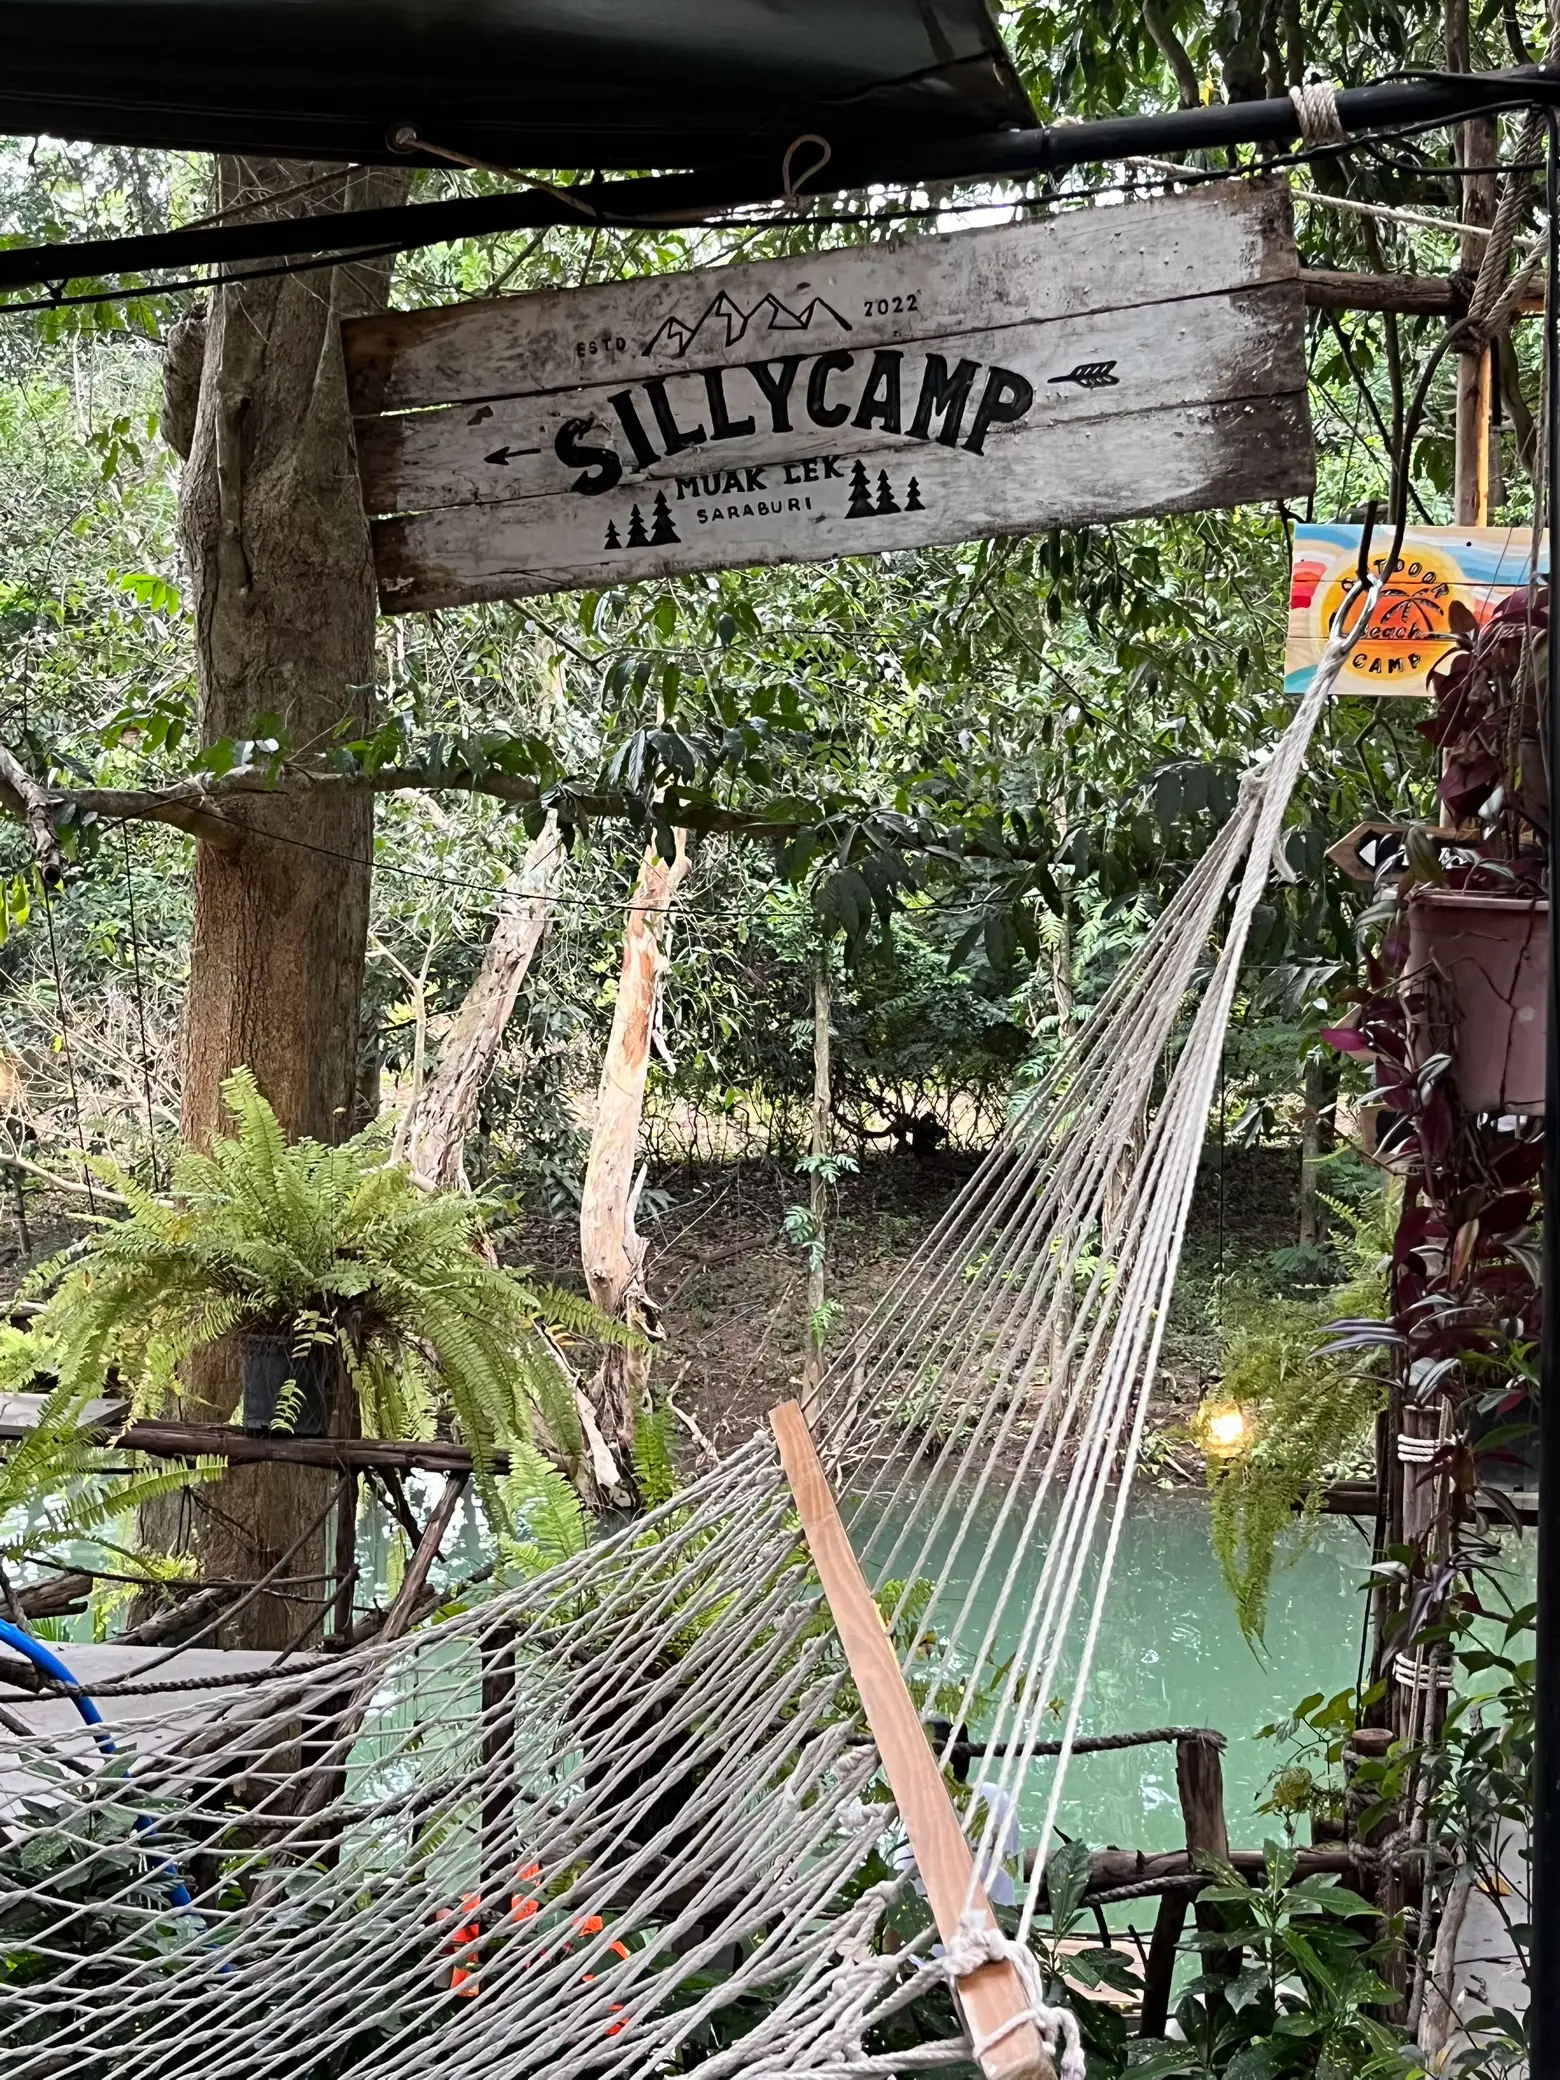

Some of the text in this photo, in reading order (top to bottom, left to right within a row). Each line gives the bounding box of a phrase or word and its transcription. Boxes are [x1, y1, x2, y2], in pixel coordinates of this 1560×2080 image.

[863, 294, 919, 317] 2022
[576, 337, 627, 358] ESTD
[554, 349, 1034, 496] SILLYCAMP
[676, 456, 845, 500] MUAK LEK
[696, 496, 813, 525] SARABURI
[1352, 652, 1422, 674] CAMP
